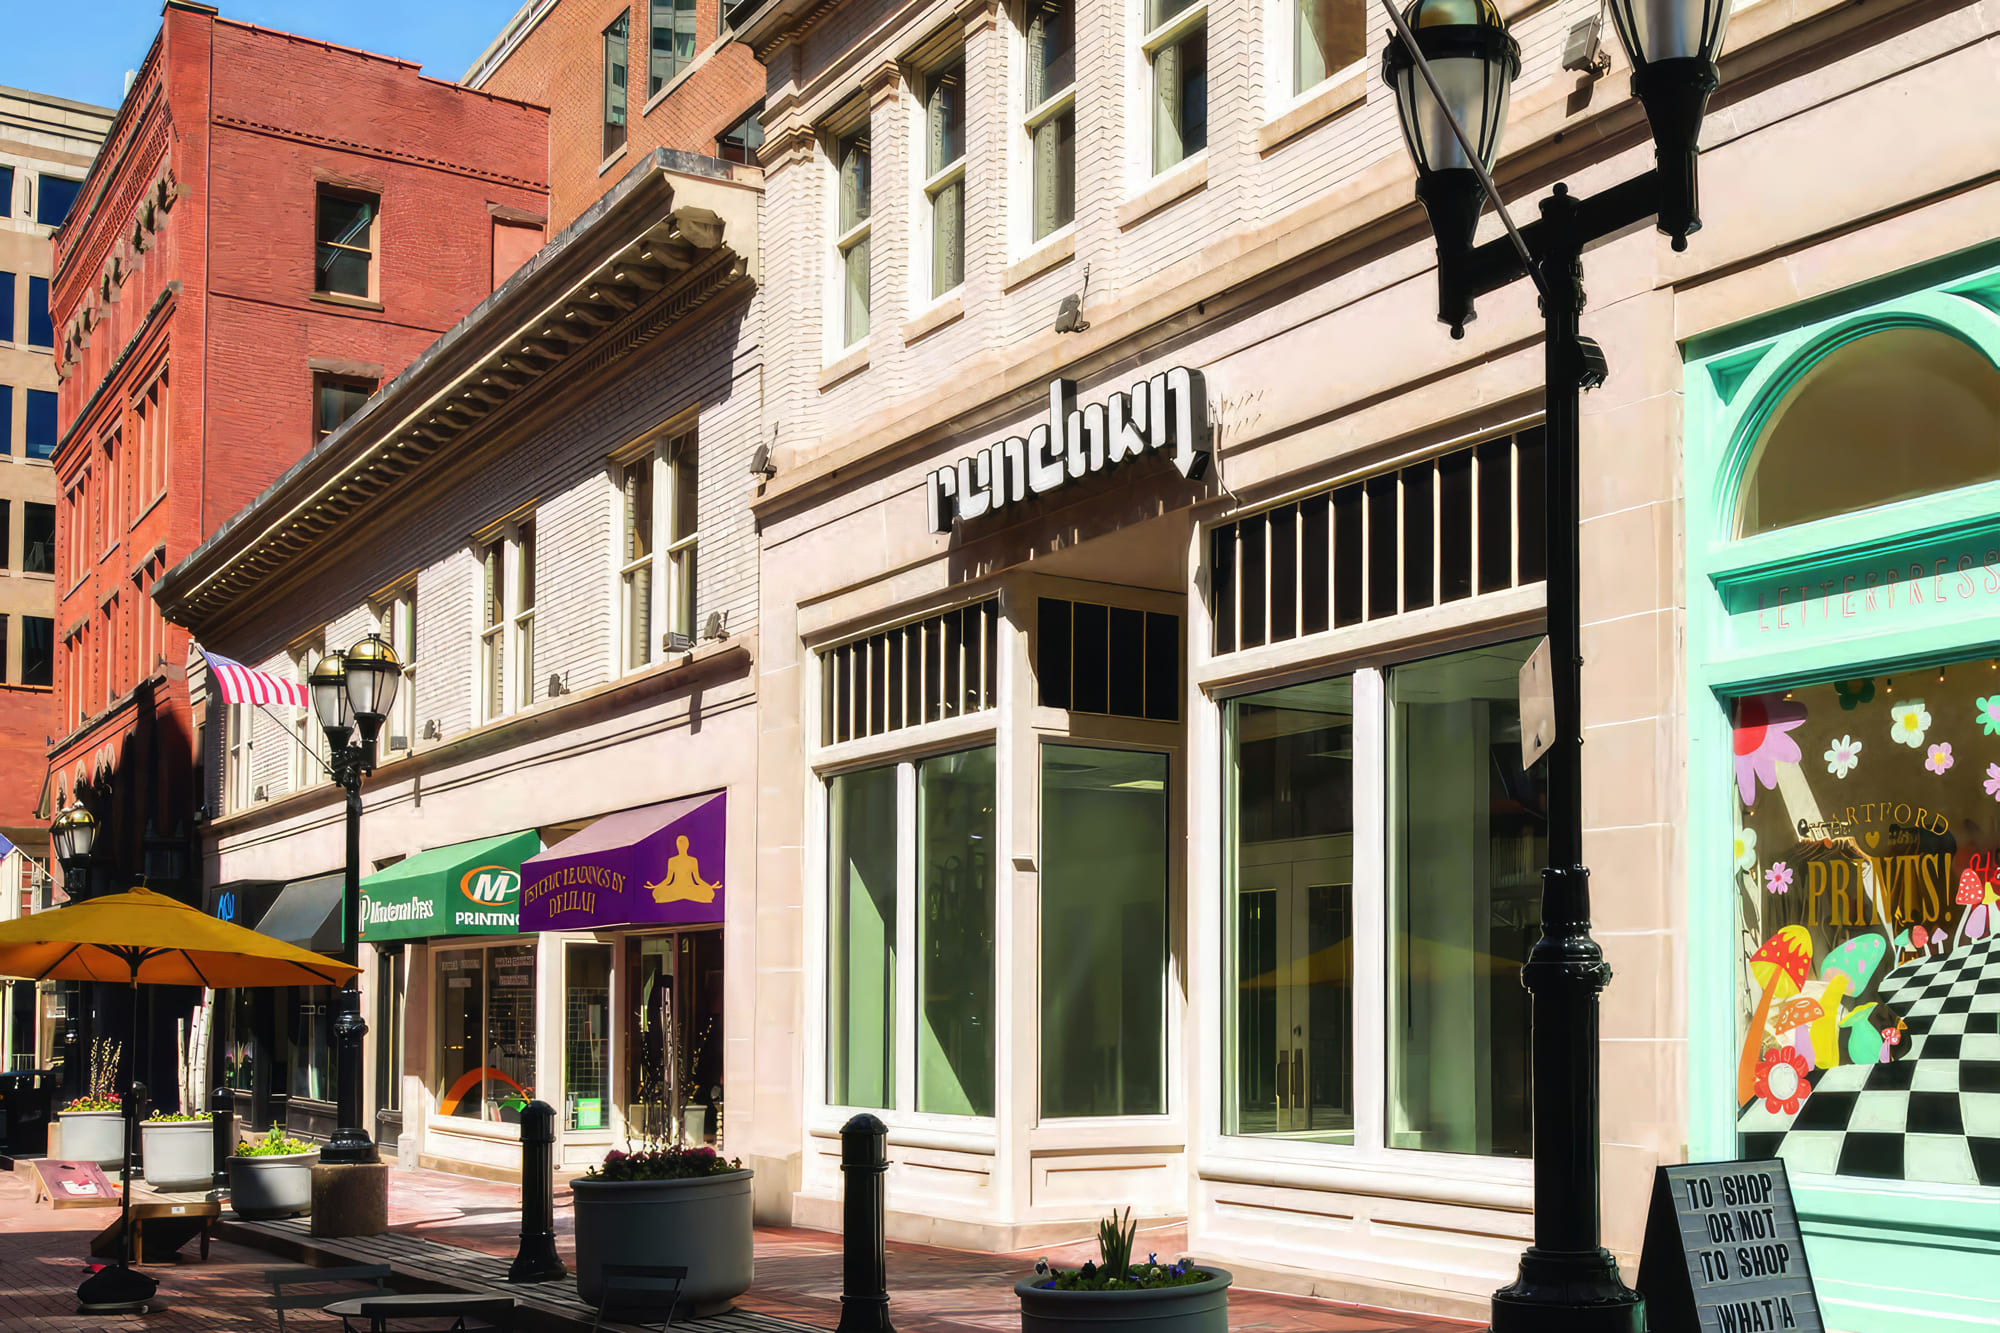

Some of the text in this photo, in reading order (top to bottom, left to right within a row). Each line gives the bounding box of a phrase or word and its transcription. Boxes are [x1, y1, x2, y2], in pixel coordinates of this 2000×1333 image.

[927, 365, 1209, 534] rundown
[1757, 549, 2000, 632] LETTERPRESS
[1820, 803, 1949, 838] ARTFORD
[1807, 852, 1952, 927] PRINTS!
[1686, 1173, 1773, 1210] TO SHOP
[1708, 1208, 1776, 1244] OR NOT
[1701, 1243, 1790, 1282] TO SHOP
[1717, 1297, 1796, 1333] WHAT A
